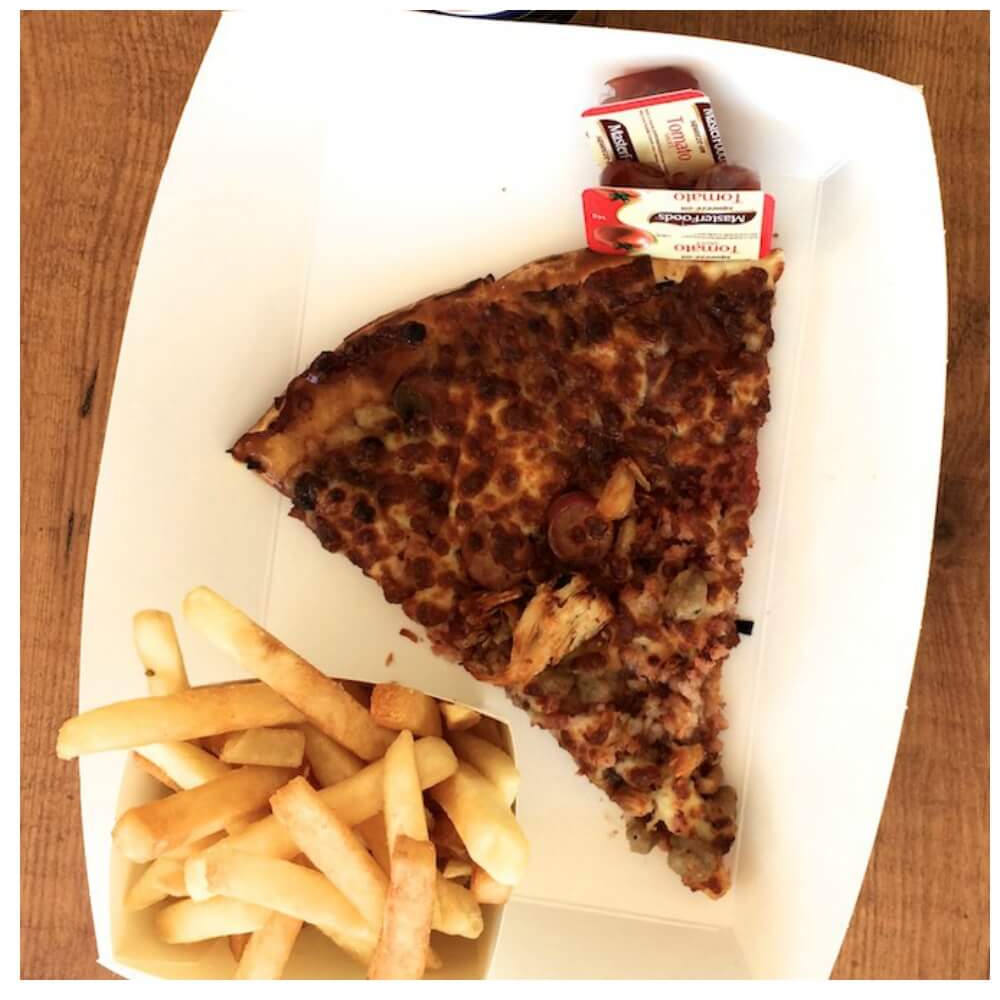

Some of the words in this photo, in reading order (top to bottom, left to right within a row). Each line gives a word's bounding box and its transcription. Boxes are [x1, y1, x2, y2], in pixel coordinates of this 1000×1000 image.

[607, 124, 633, 160] MasterF
[666, 116, 692, 161] Tomato
[673, 192, 743, 204] Tomato
[658, 213, 747, 223] MasterFoods
[673, 243, 740, 254] Tomato
